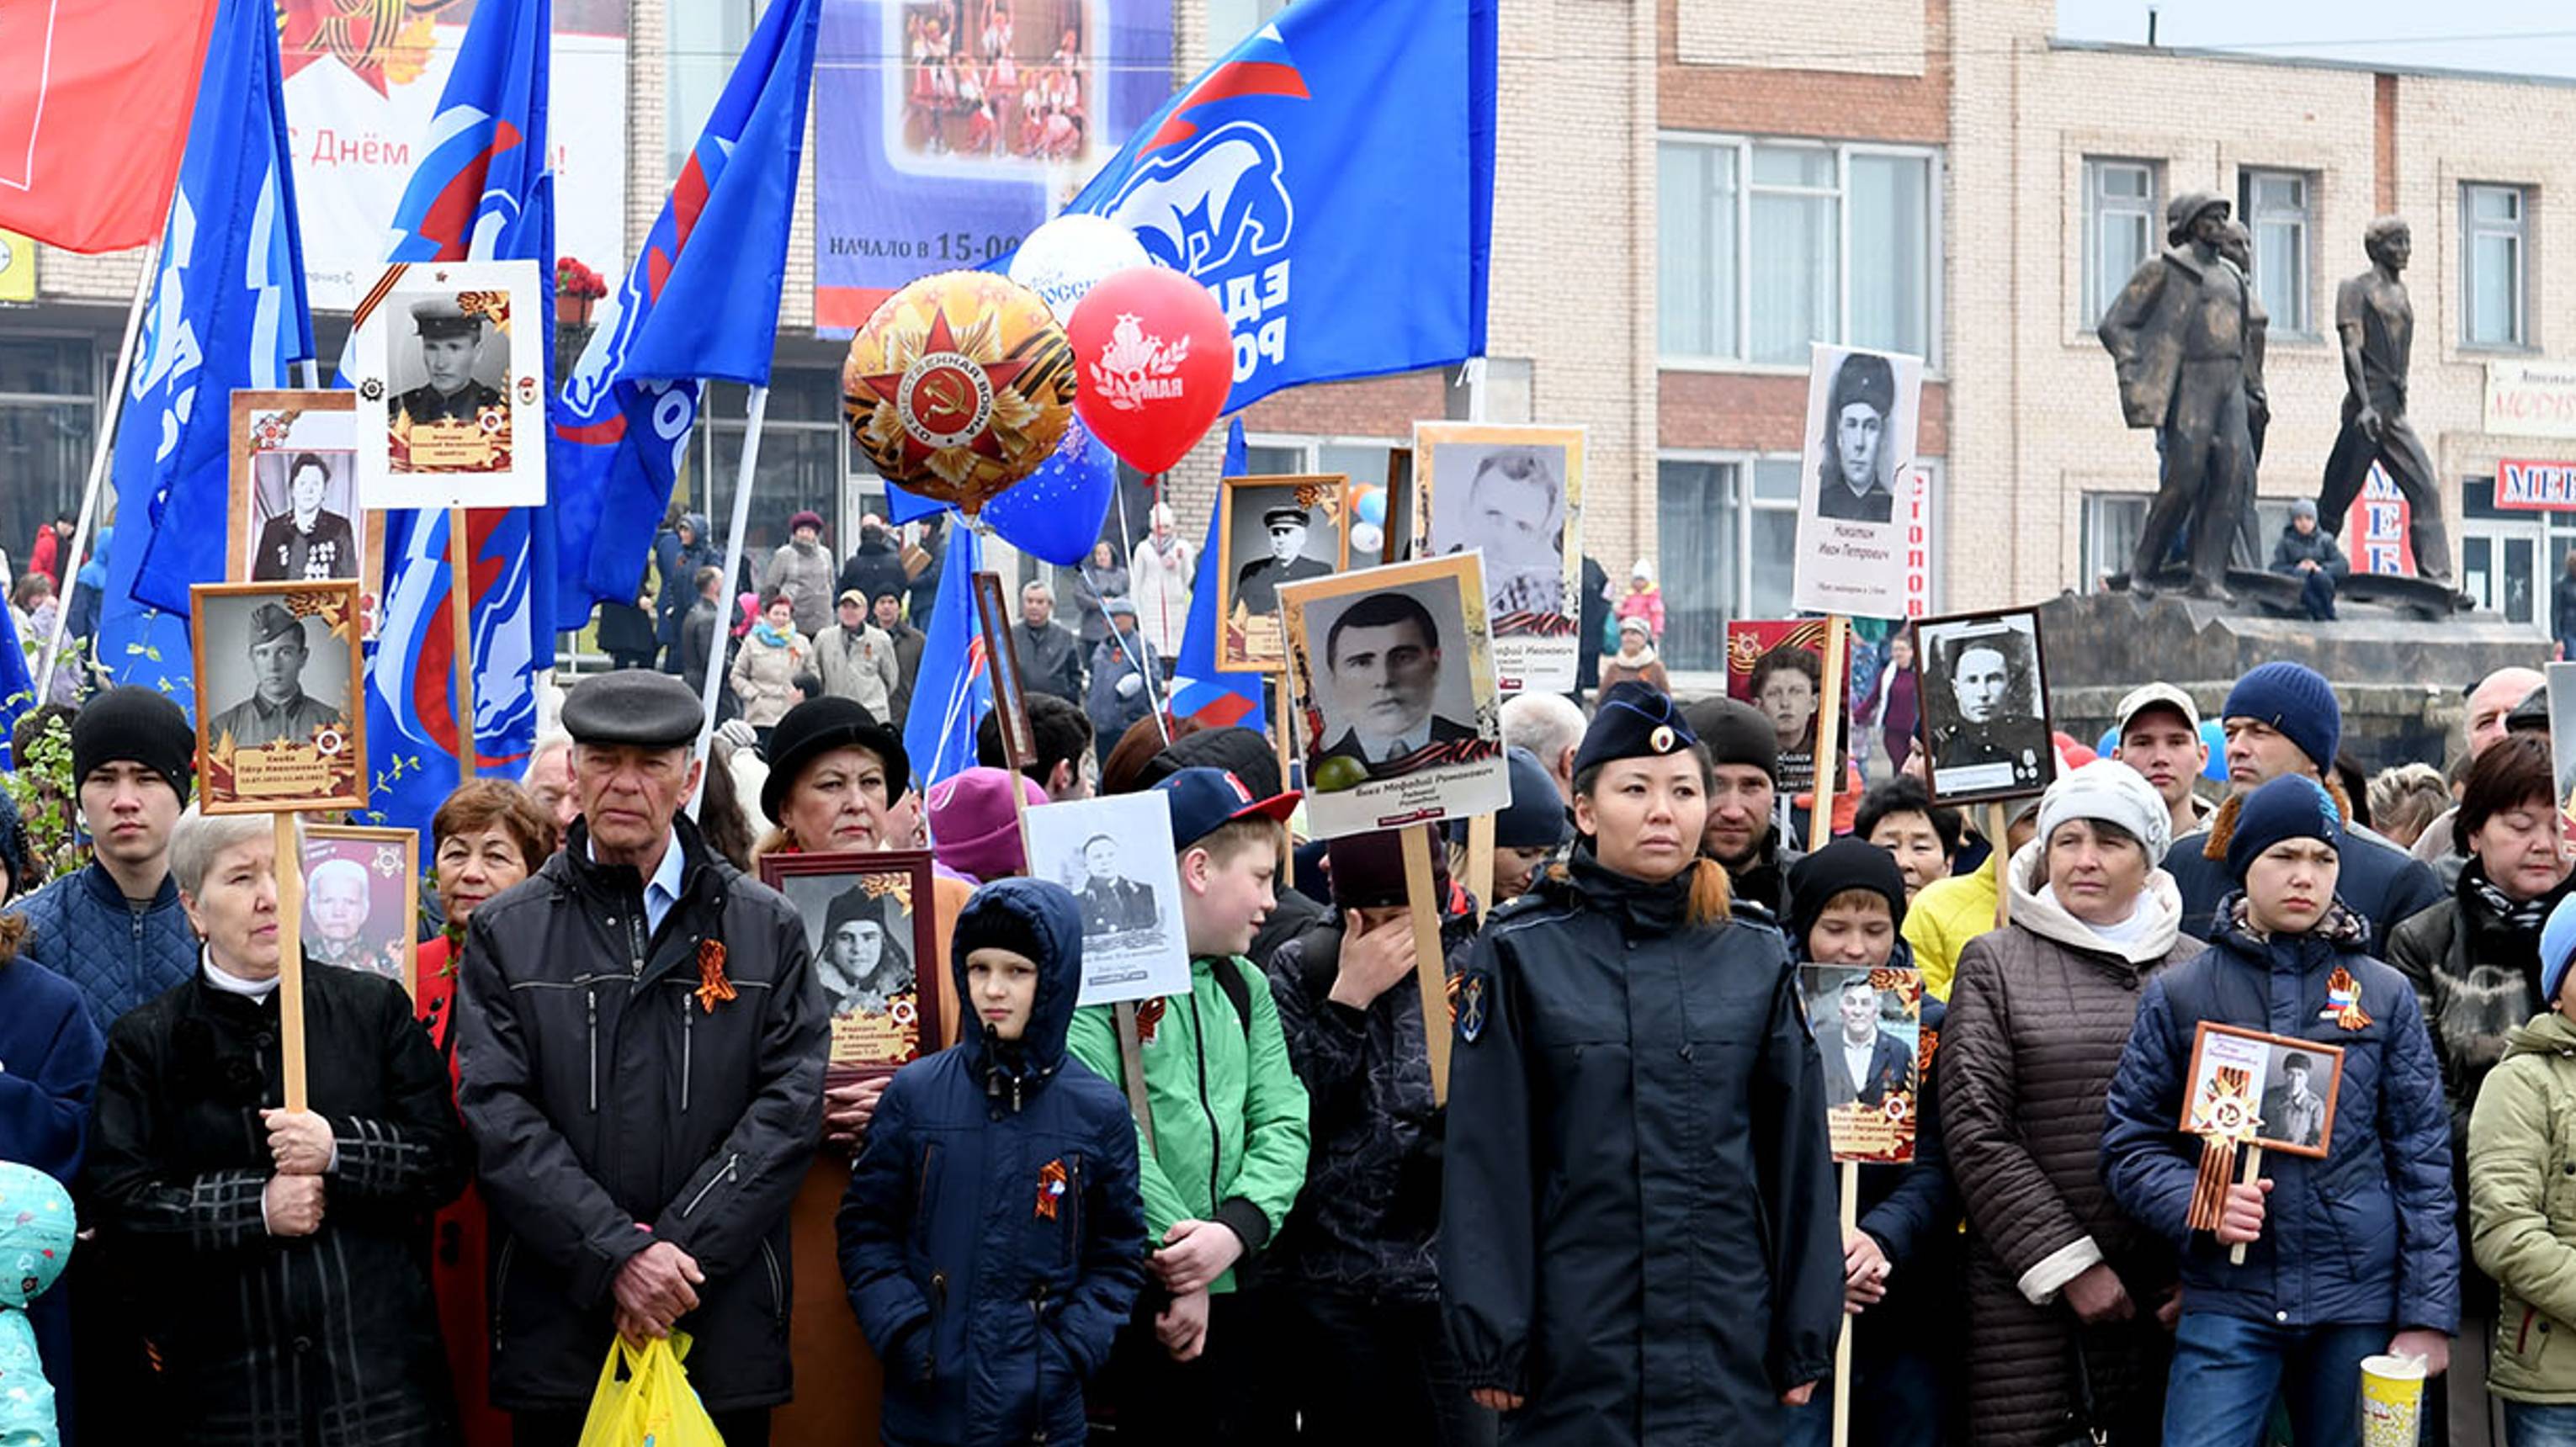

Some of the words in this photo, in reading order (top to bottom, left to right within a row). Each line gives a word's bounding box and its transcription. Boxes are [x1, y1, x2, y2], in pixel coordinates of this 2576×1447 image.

[311, 129, 409, 167] Днём
[830, 237, 911, 258] НАЧАЛО
[1142, 378, 1183, 400] МАЯ
